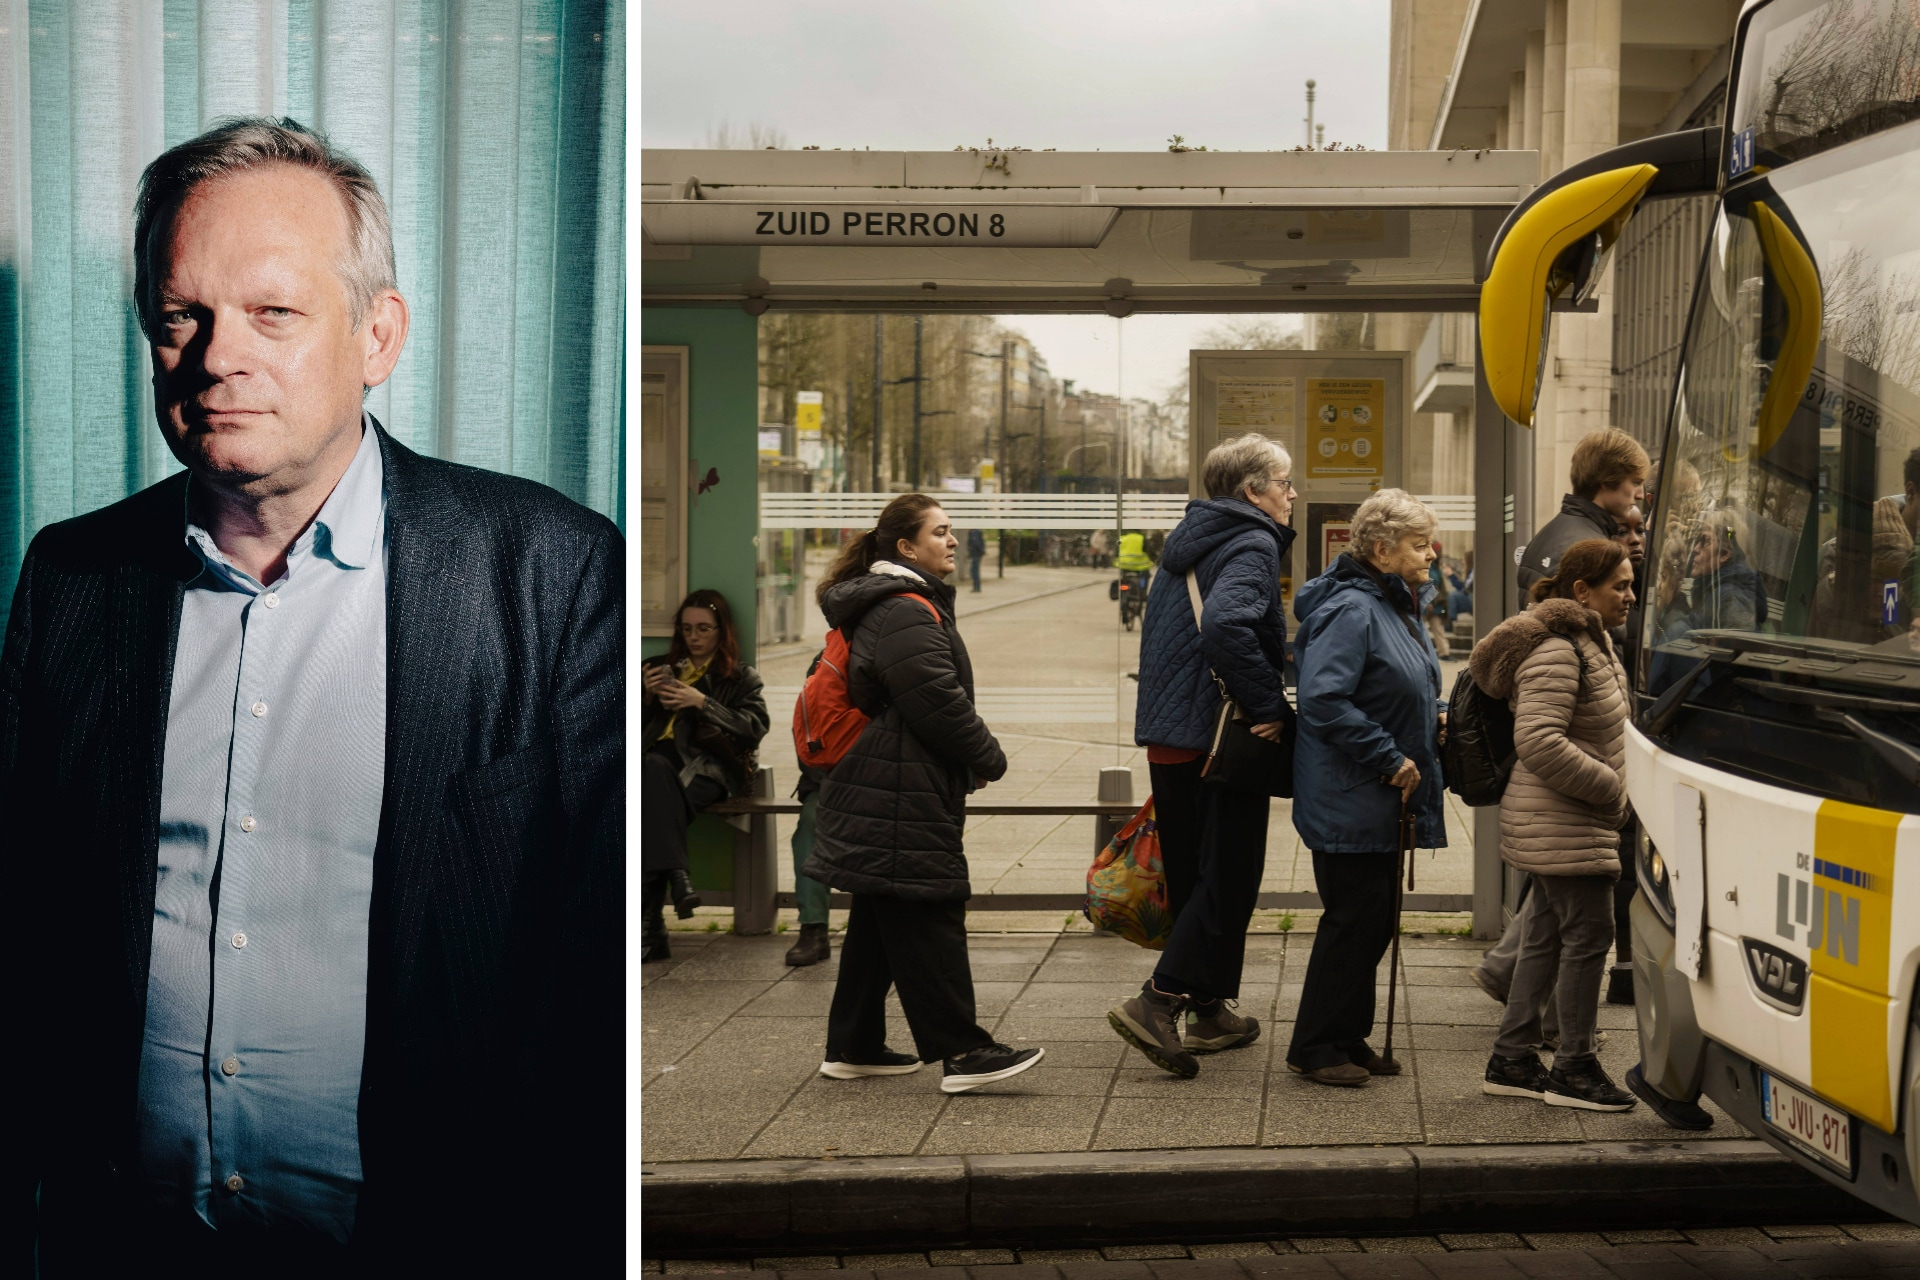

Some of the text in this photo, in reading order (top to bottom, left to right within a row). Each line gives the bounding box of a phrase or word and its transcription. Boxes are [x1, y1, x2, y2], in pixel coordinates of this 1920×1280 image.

[756, 211, 1005, 237] ZUID PERRON 8
[1796, 852, 1810, 871] DE
[1776, 872, 1861, 967] LIJN
[1751, 948, 1799, 995] VDL
[1772, 1086, 1849, 1161] 1-JVU-871
